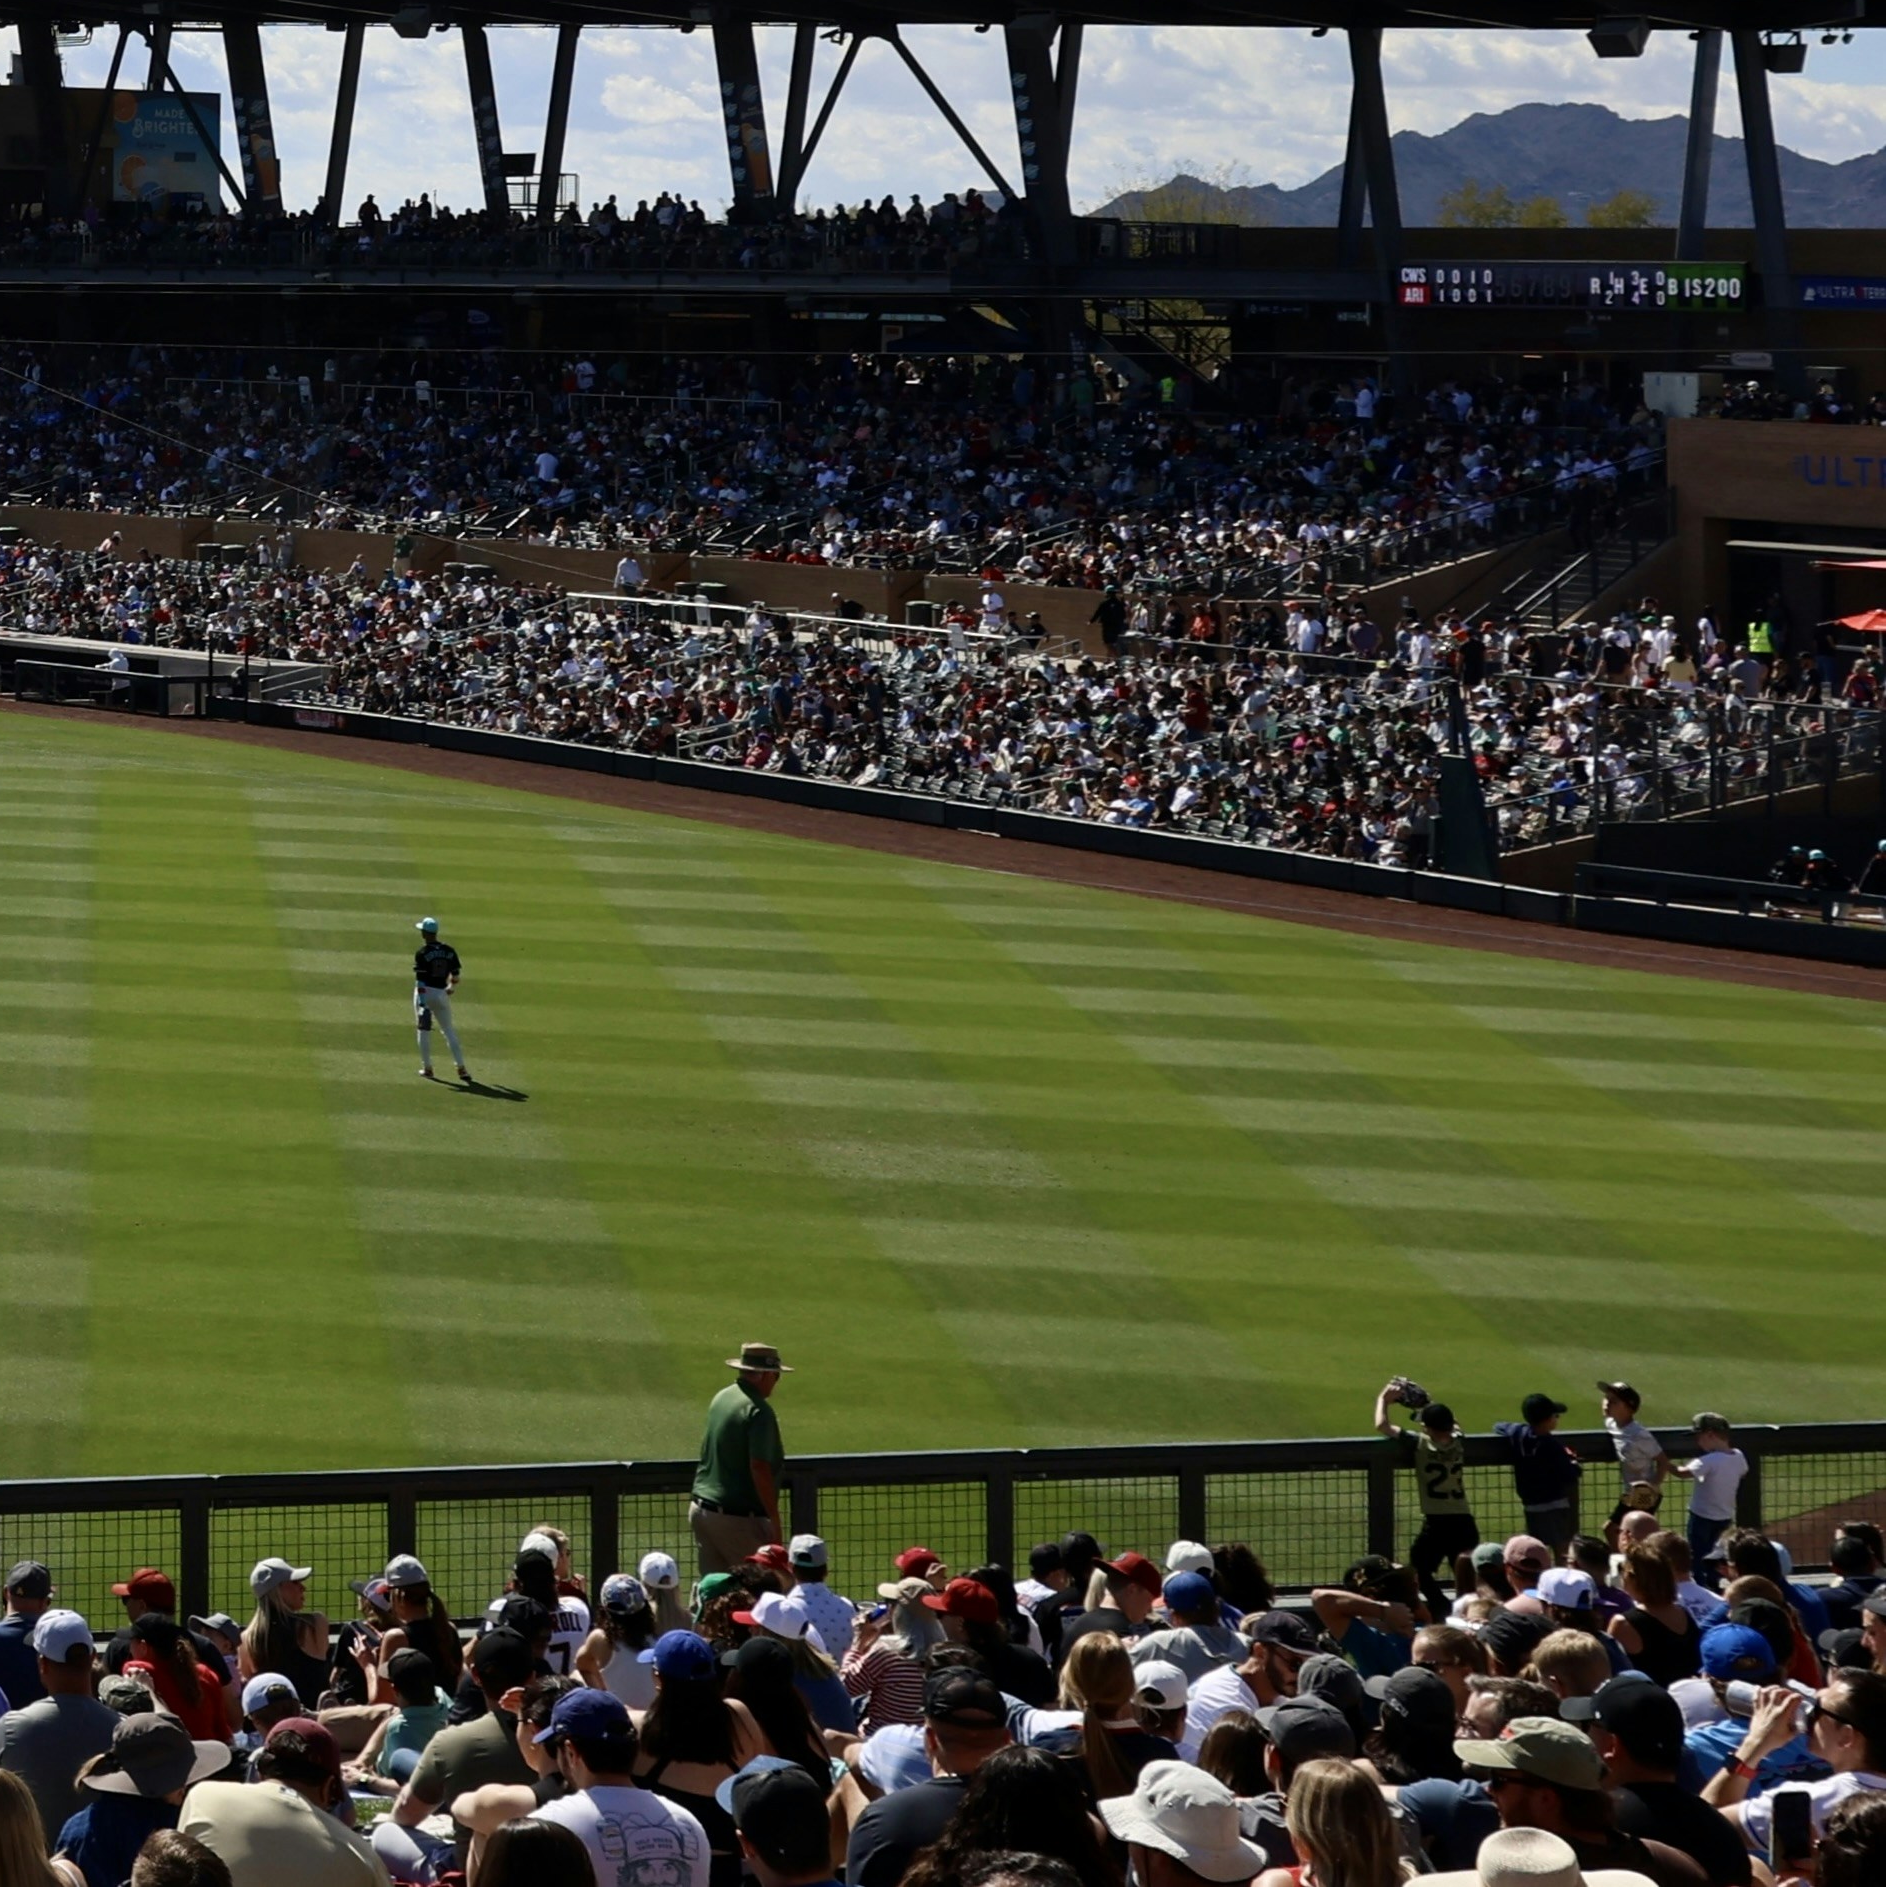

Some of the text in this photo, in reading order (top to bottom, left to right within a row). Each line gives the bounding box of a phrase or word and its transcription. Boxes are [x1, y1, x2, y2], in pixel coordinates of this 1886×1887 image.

[154, 109, 185, 119] MADE
[131, 118, 199, 139] BRIGHTE
[1401, 267, 1427, 284] CWS
[1436, 269, 1445, 284] 0
[1451, 269, 1461, 284] 0
[1483, 269, 1493, 284] 0
[1631, 270, 1640, 286] 3
[1655, 271, 1665, 286] 0
[1589, 277, 1601, 294] R
[1613, 277, 1624, 295] H
[1639, 278, 1649, 295] E
[1820, 286, 1856, 299] ULTRA
[1404, 287, 1425, 303] ARI
[1451, 288, 1461, 303] 0
[1467, 288, 1477, 303] 0
[1604, 291, 1614, 305] 2
[1631, 291, 1640, 305] 4
[1656, 291, 1666, 306] 0
